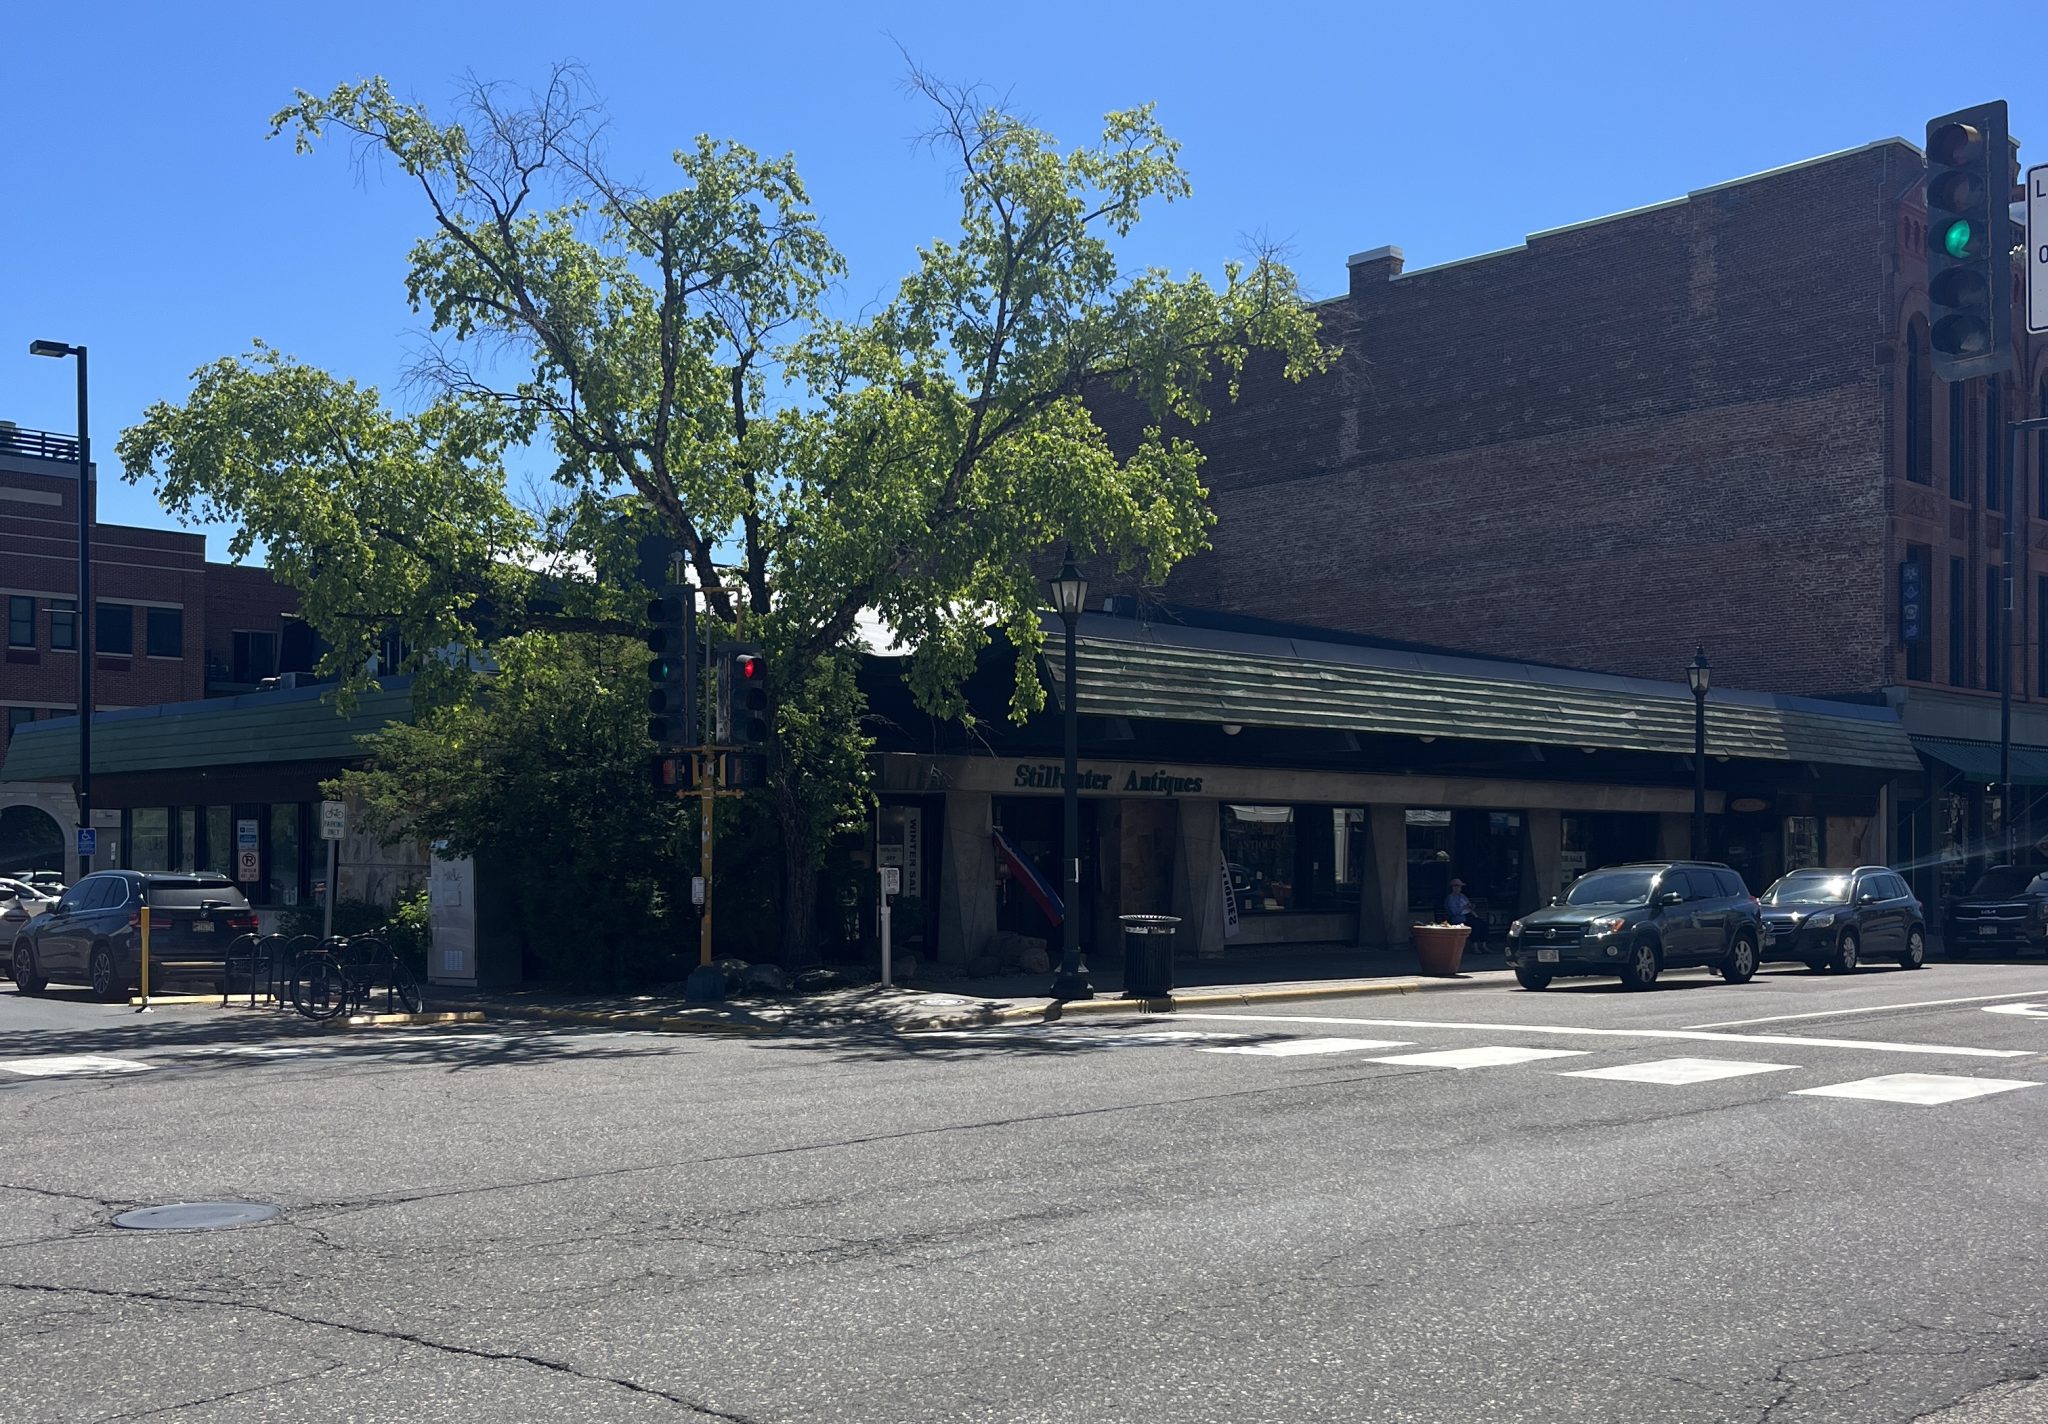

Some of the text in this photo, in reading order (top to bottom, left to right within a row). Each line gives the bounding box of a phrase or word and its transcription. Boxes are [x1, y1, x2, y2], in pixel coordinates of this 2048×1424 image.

[1123, 769, 1203, 797] Antiques
[909, 818, 917, 897] WINTER SAL
